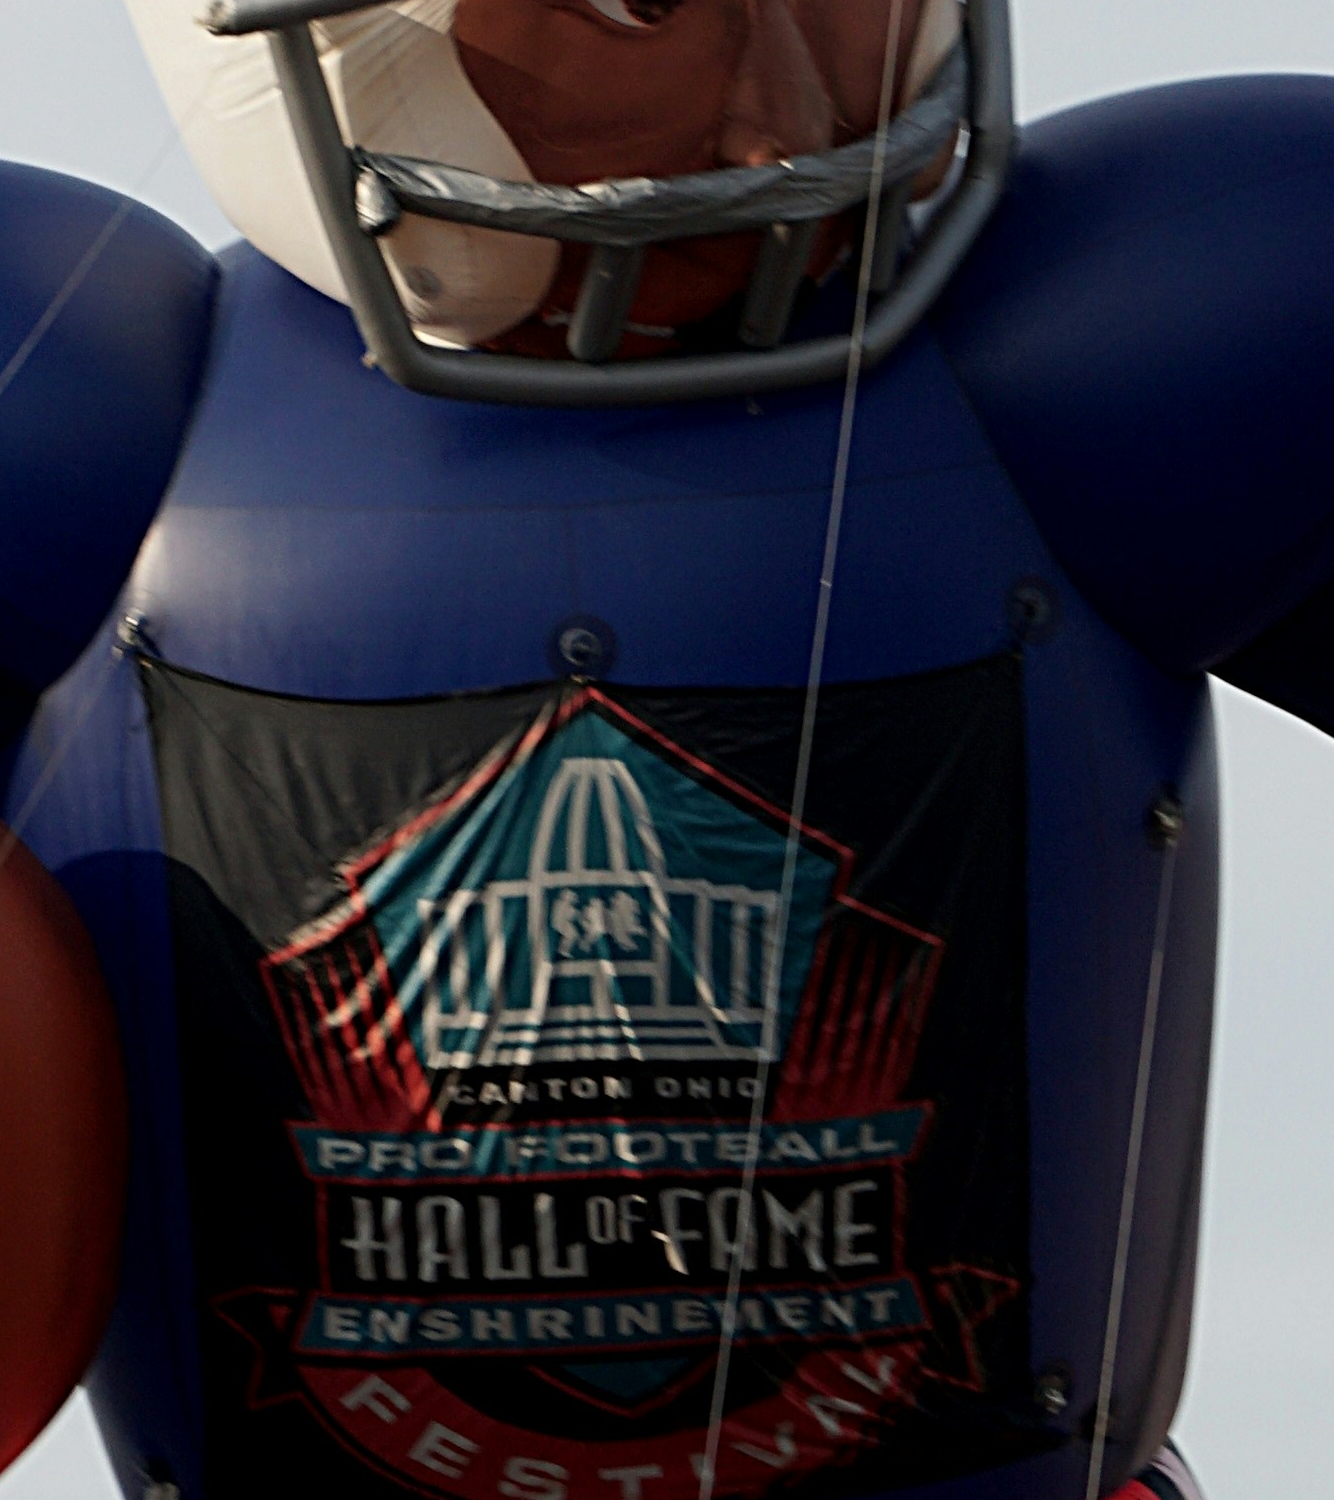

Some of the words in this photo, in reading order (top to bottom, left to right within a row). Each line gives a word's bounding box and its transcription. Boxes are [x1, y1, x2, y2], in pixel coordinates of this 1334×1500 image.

[452, 1076, 632, 1106] CANTON
[654, 1077, 761, 1099] OHIO
[317, 1137, 471, 1171] PRO
[506, 1123, 898, 1166] FOOTBALL
[342, 1194, 588, 1282] HALL
[586, 1194, 646, 1244] OF
[651, 1180, 878, 1275] FAME
[323, 1289, 899, 1343] ENSHRINEMENT
